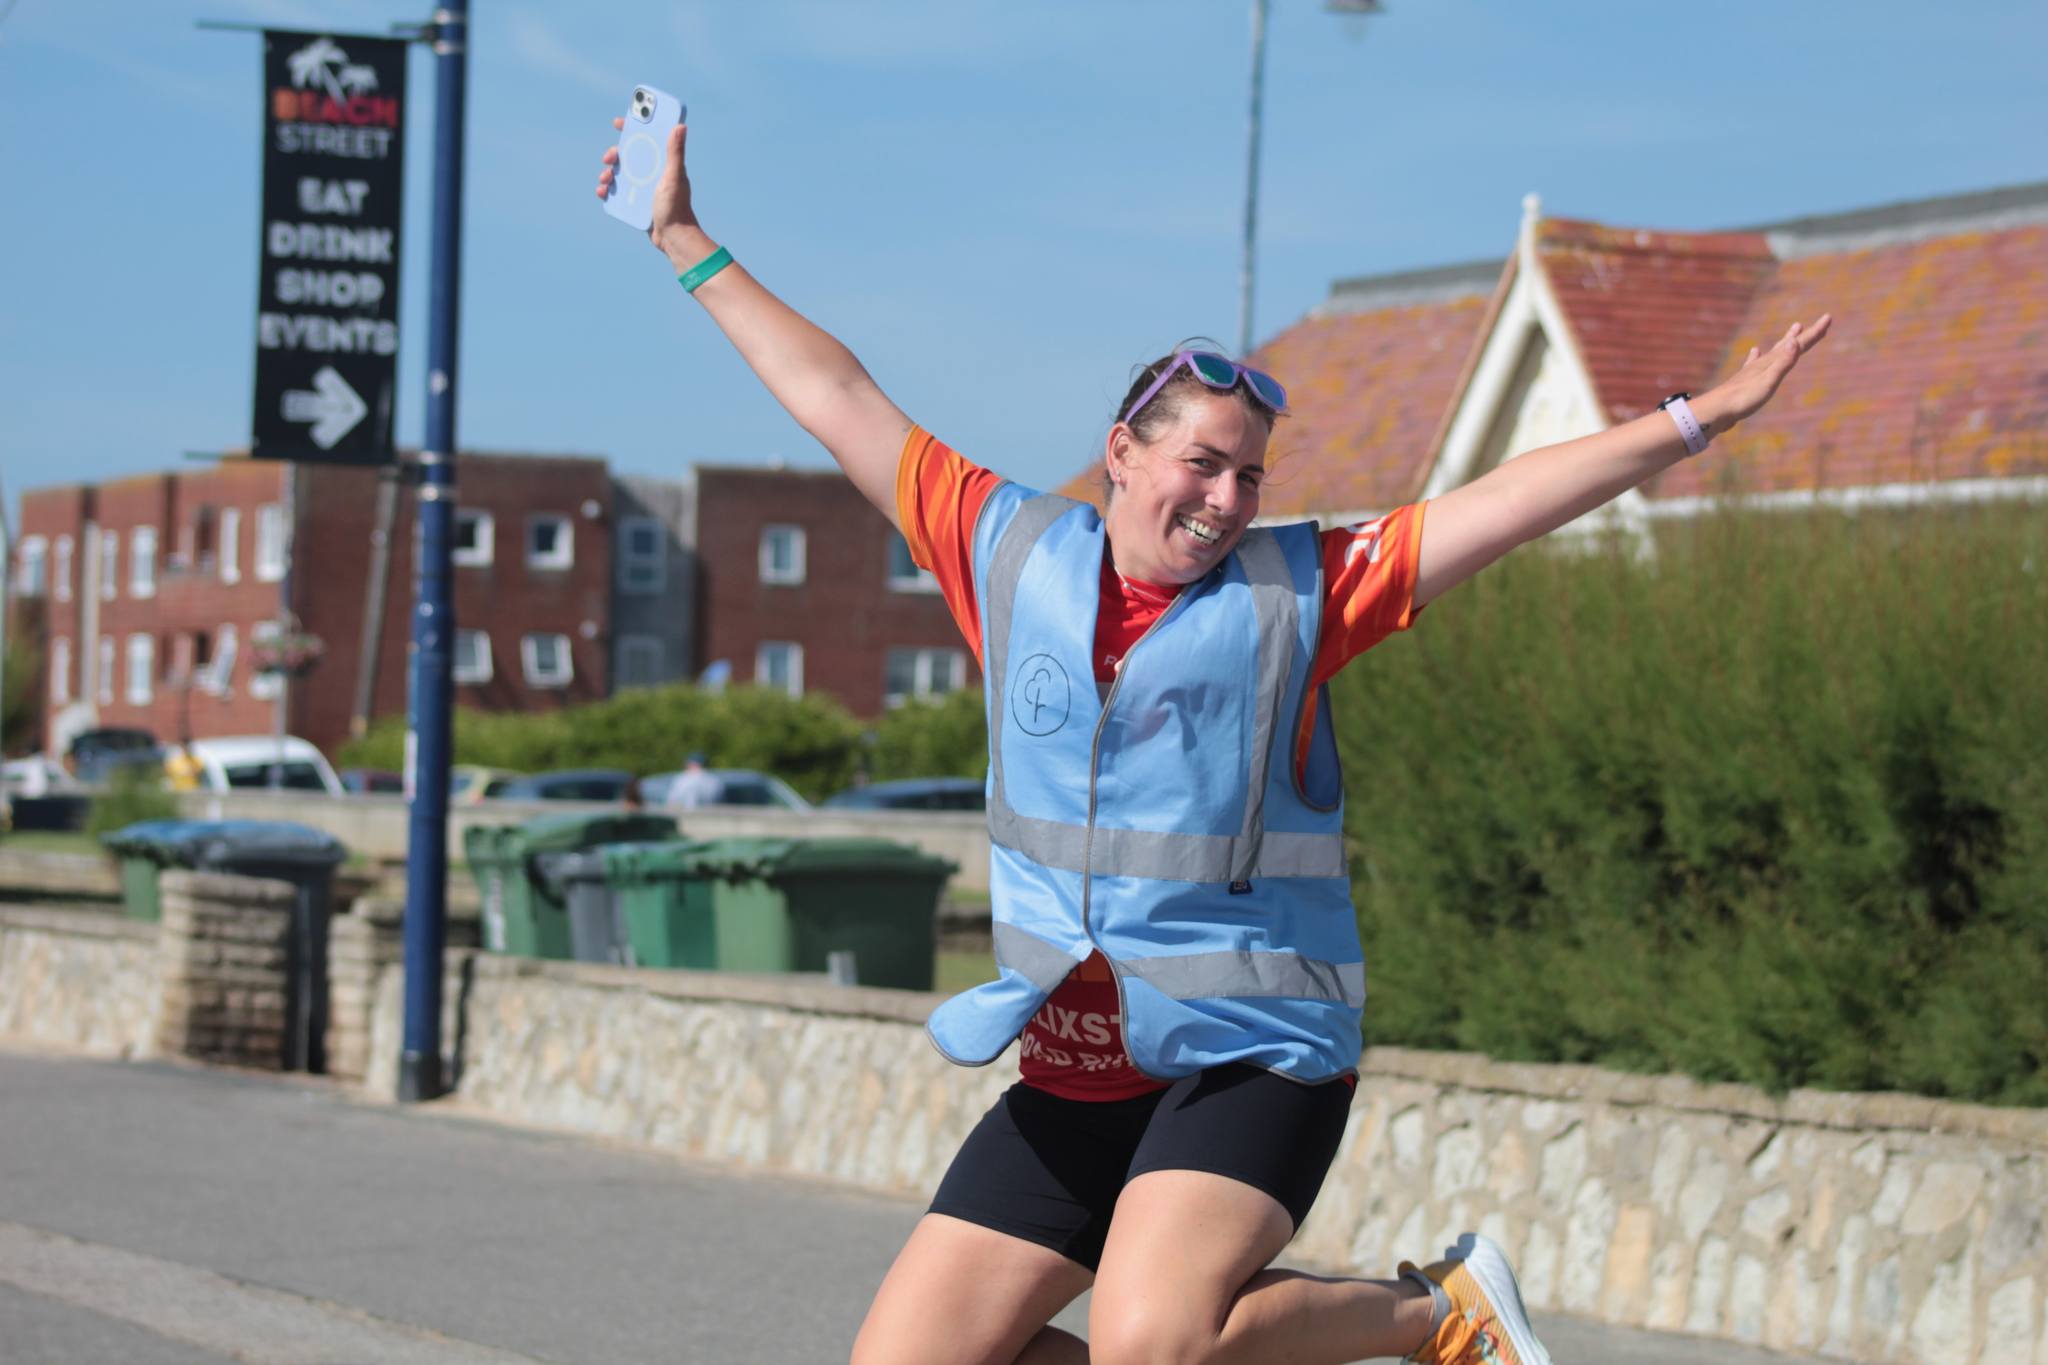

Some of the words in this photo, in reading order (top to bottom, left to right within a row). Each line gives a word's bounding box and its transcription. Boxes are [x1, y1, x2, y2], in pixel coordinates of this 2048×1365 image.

[273, 88, 397, 128] BEACH
[276, 123, 392, 158] STREET
[298, 177, 369, 215] EAT
[269, 221, 393, 263] DRINK
[275, 267, 385, 309] SHOP
[259, 312, 396, 355] EVENTS
